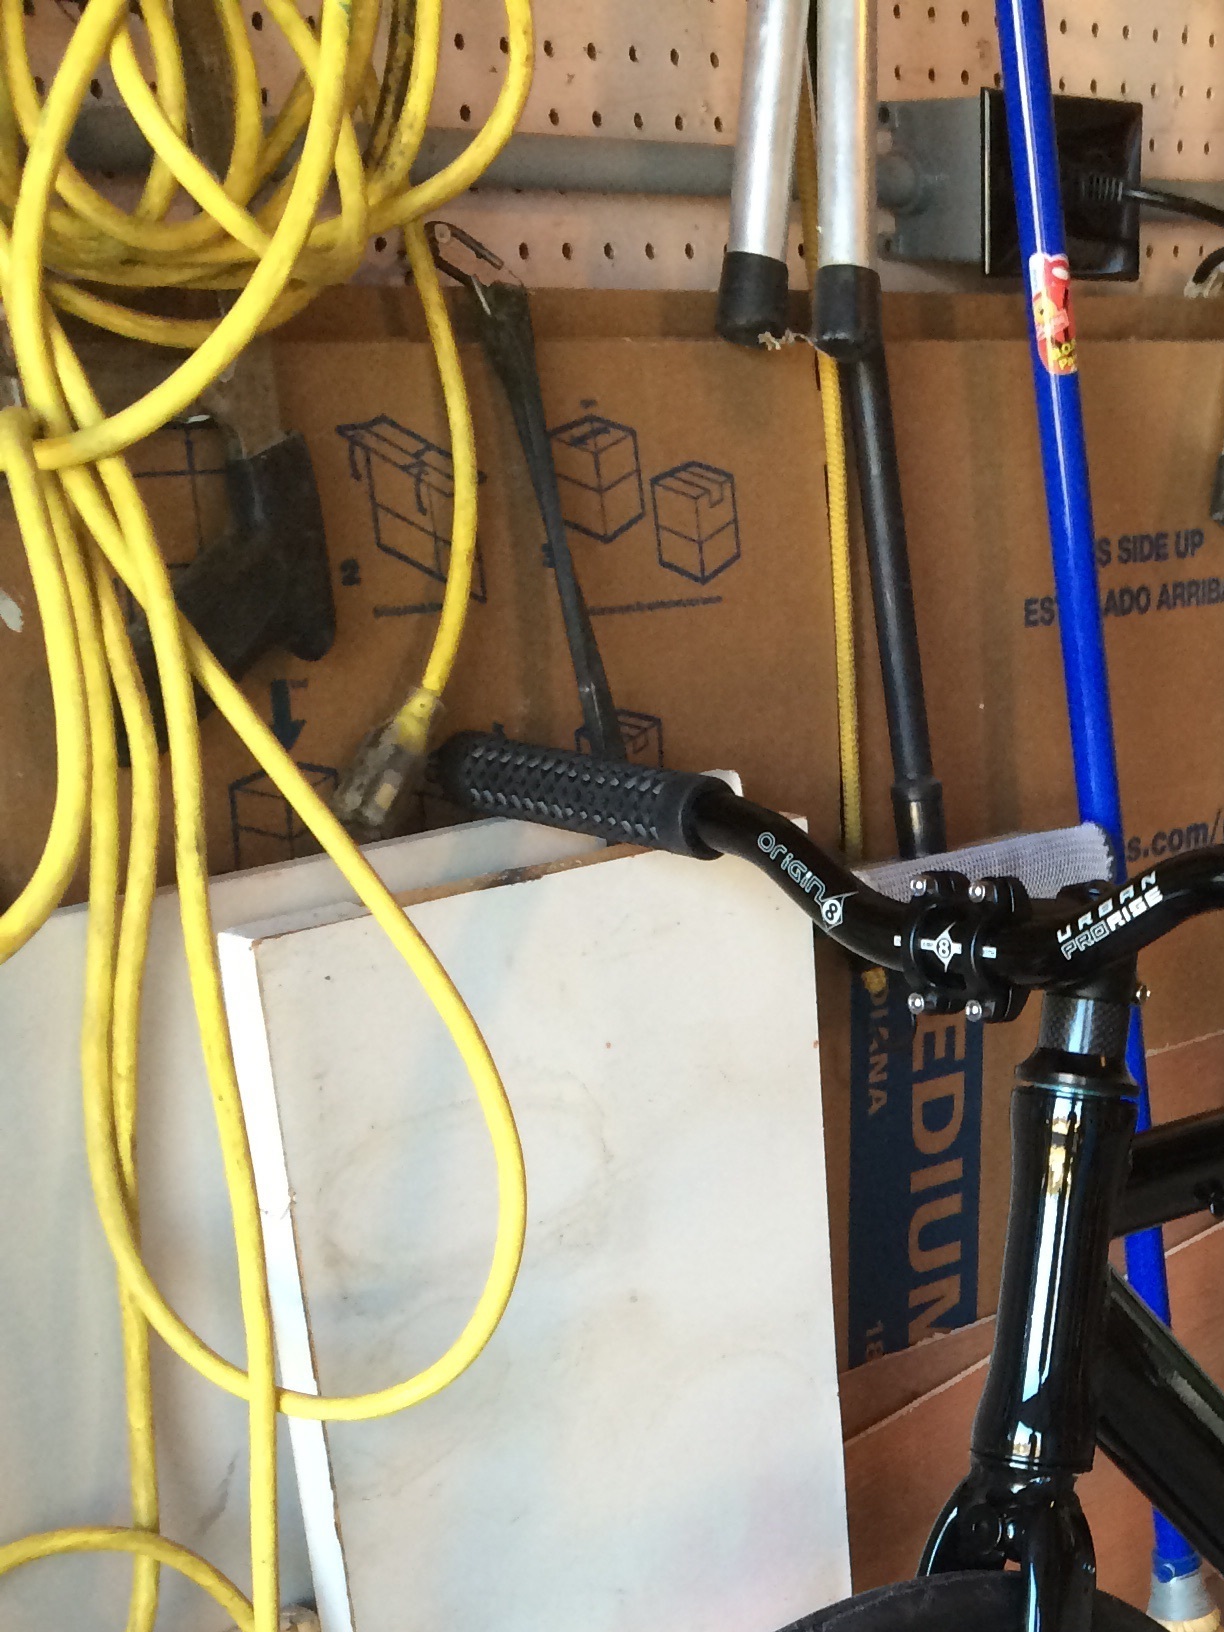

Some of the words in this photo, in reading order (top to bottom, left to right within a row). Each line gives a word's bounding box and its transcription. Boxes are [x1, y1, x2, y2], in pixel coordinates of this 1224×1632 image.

[1117, 532, 1169, 564] SIDE
[1175, 528, 1204, 559] UP
[1104, 584, 1150, 617] ADO
[1057, 870, 1156, 943] URBAN
[1061, 885, 1163, 960] PRORISE
[908, 1012, 965, 1346] EDIUM
